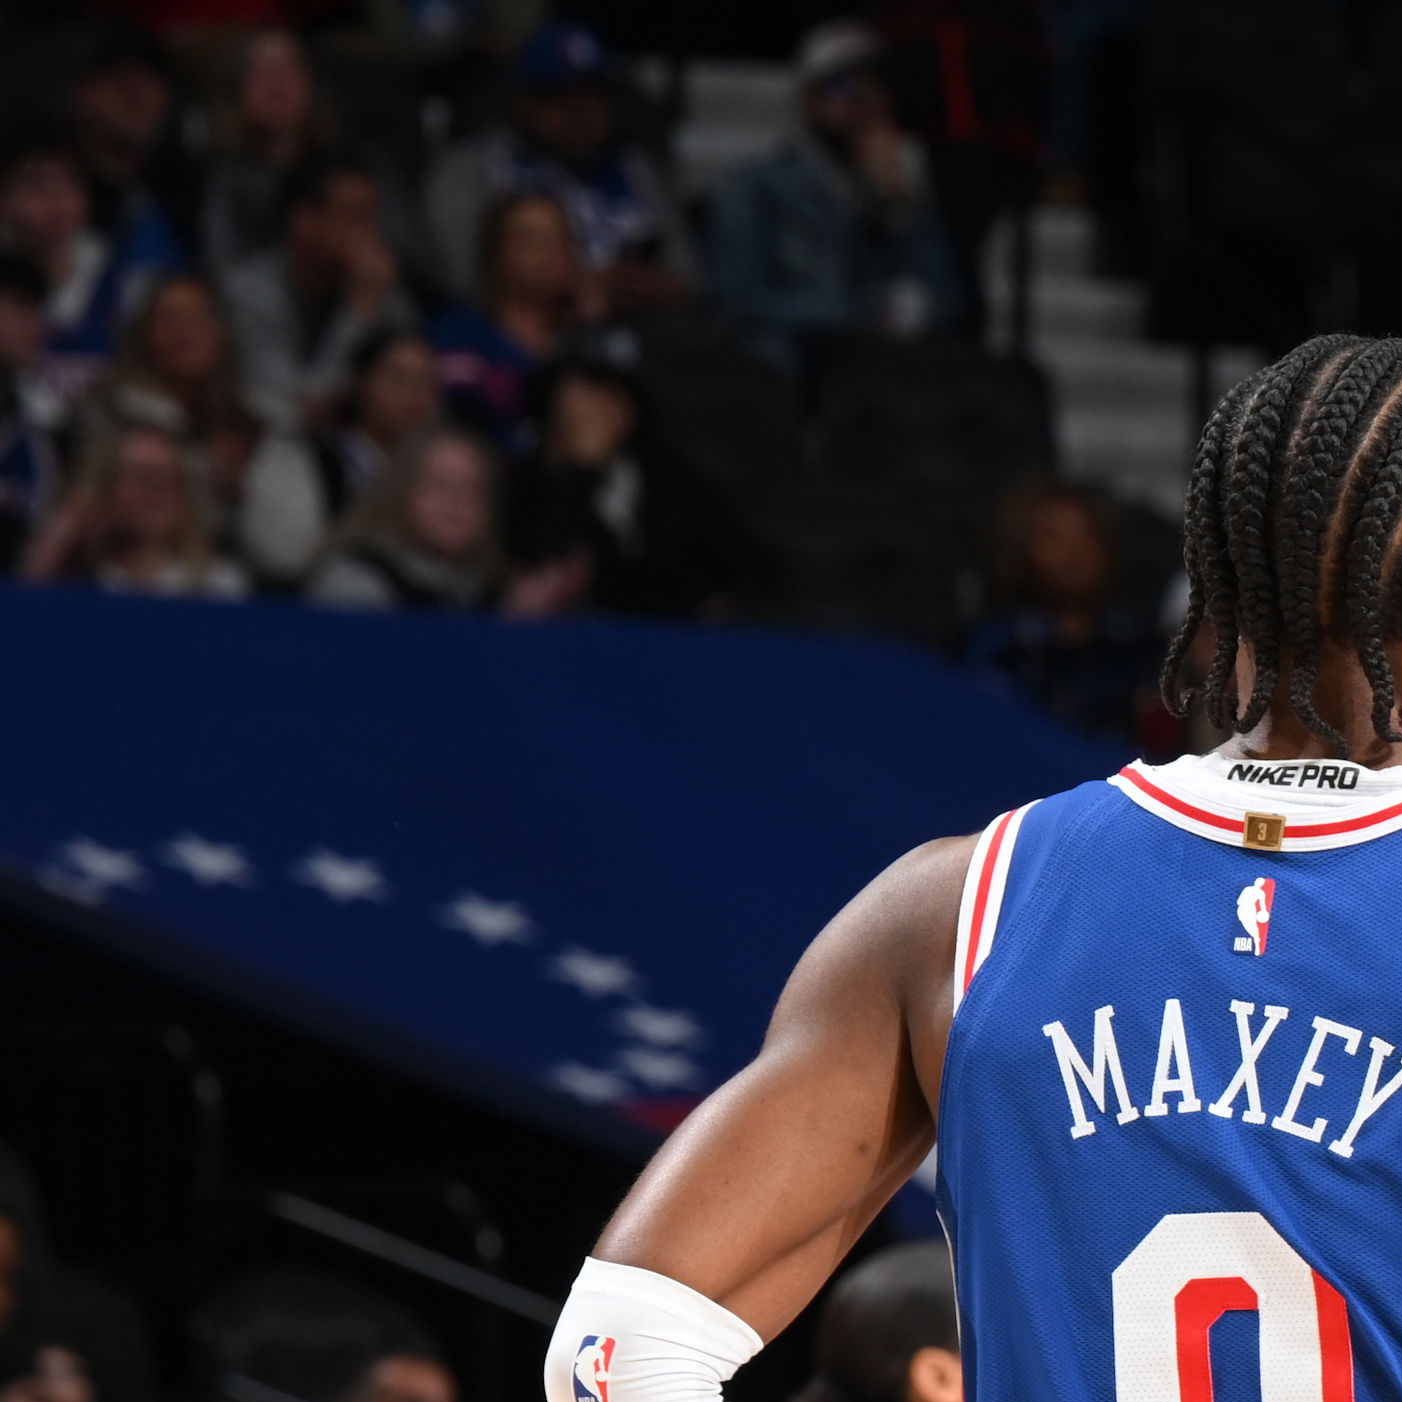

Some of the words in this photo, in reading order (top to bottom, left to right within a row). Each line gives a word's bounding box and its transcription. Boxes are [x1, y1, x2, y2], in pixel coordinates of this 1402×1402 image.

[1227, 764, 1299, 786] NIKE
[1298, 765, 1360, 789] PRO
[1257, 823, 1268, 841] 3
[1233, 937, 1253, 952] NBA
